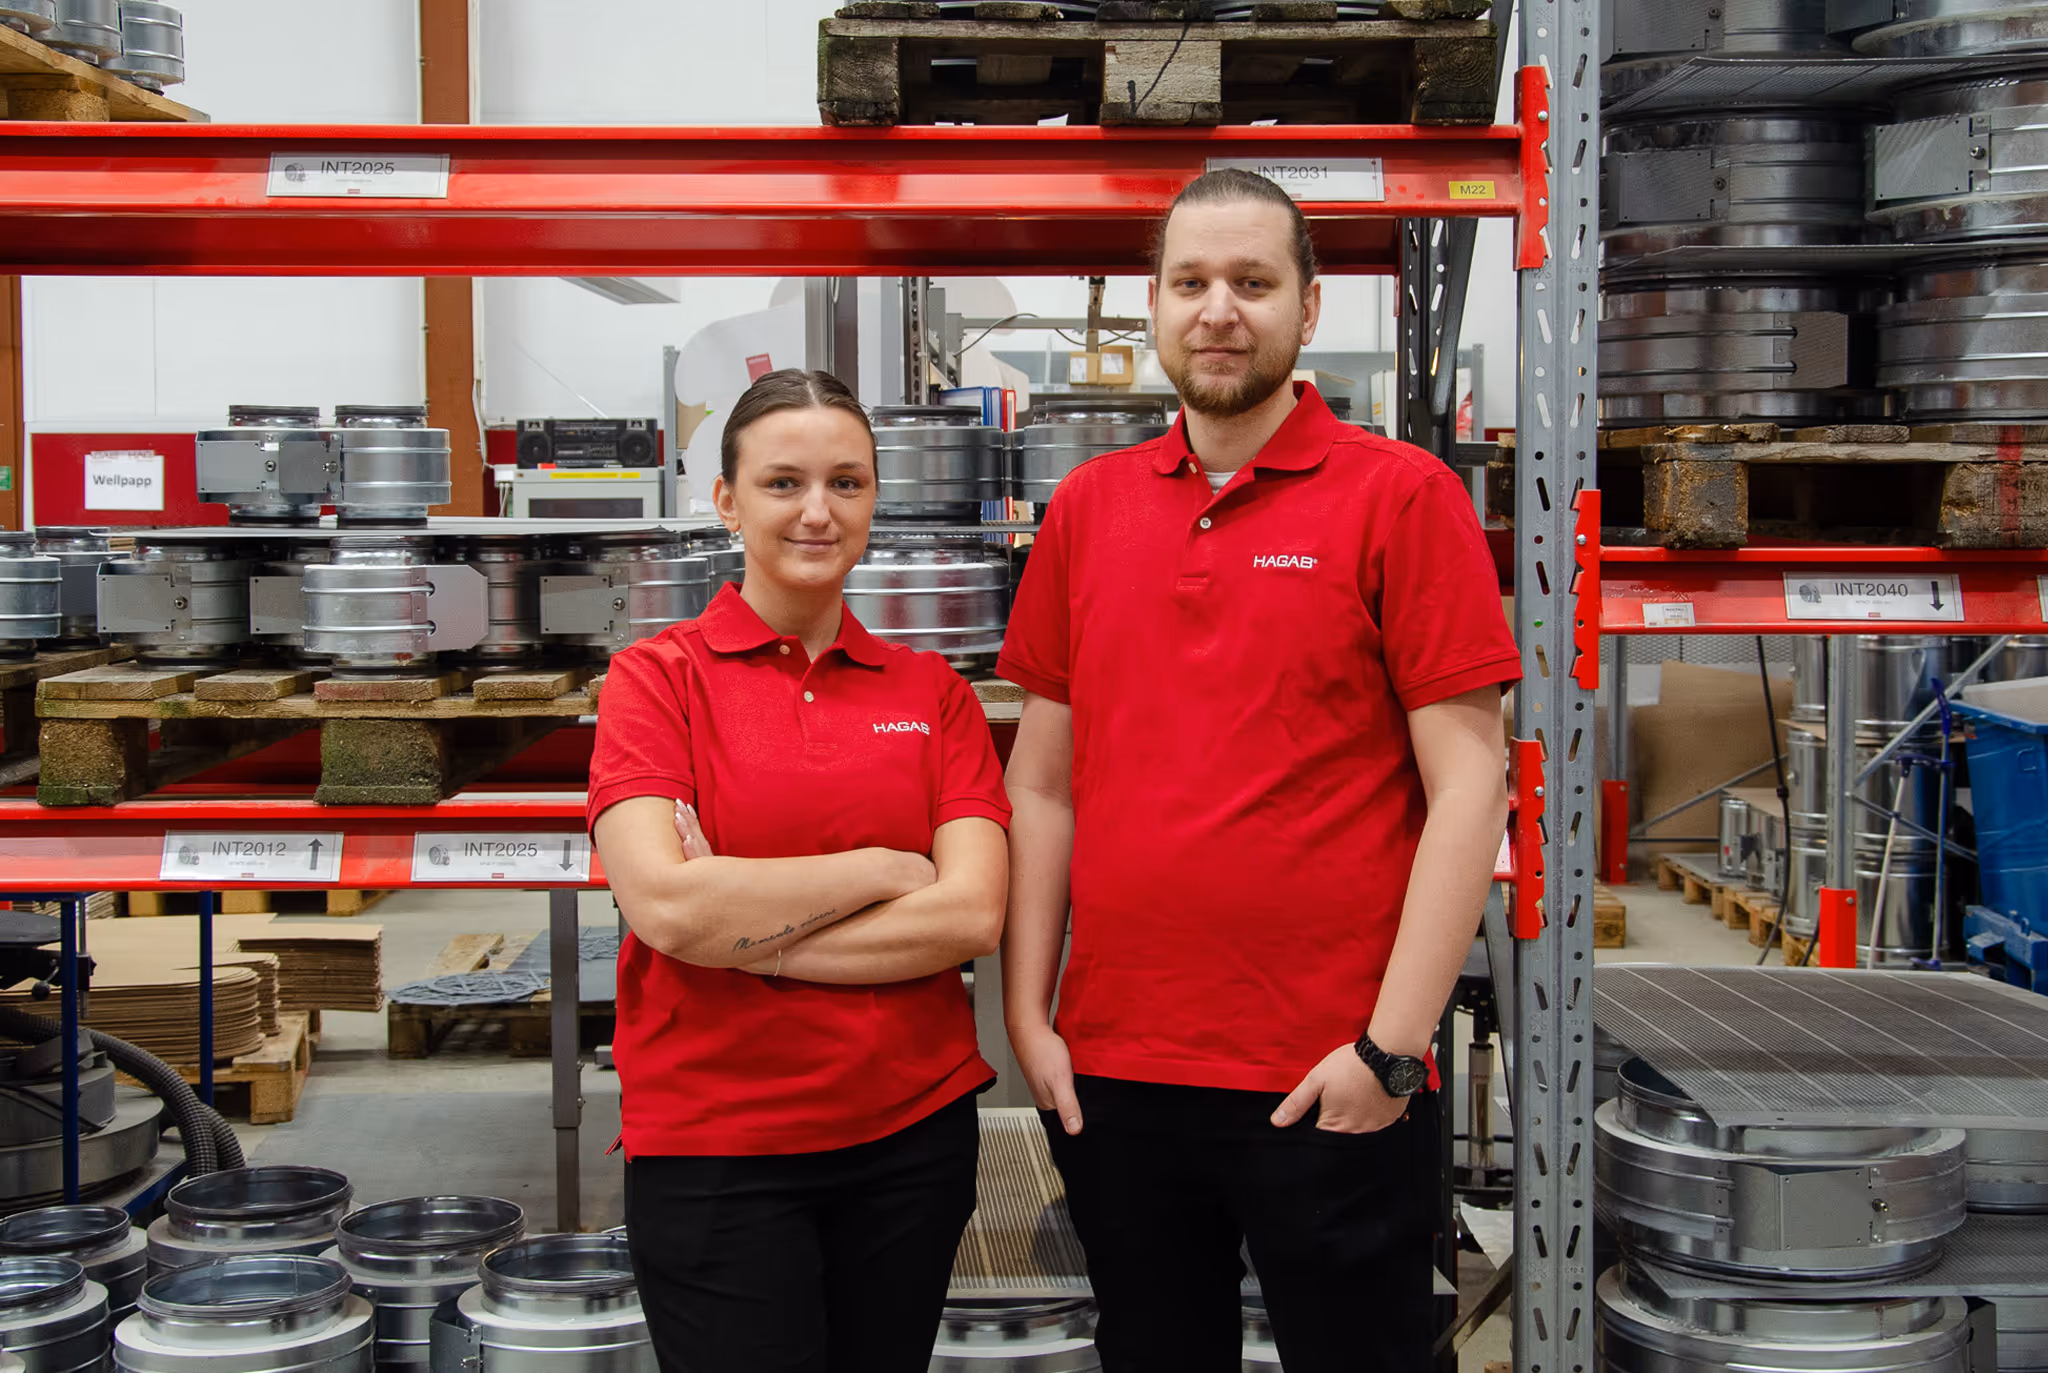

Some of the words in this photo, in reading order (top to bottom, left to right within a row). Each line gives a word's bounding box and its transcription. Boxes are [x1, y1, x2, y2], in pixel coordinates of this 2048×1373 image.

[320, 160, 395, 175] INT2025
[1257, 165, 1328, 179] INT2031
[1460, 184, 1486, 195] M22
[92, 474, 152, 488] Wellpapp
[1253, 554, 1314, 569] HAGAB
[1835, 582, 1909, 597] INT2040
[211, 841, 287, 857] INT2012
[464, 842, 538, 858] INT2025
